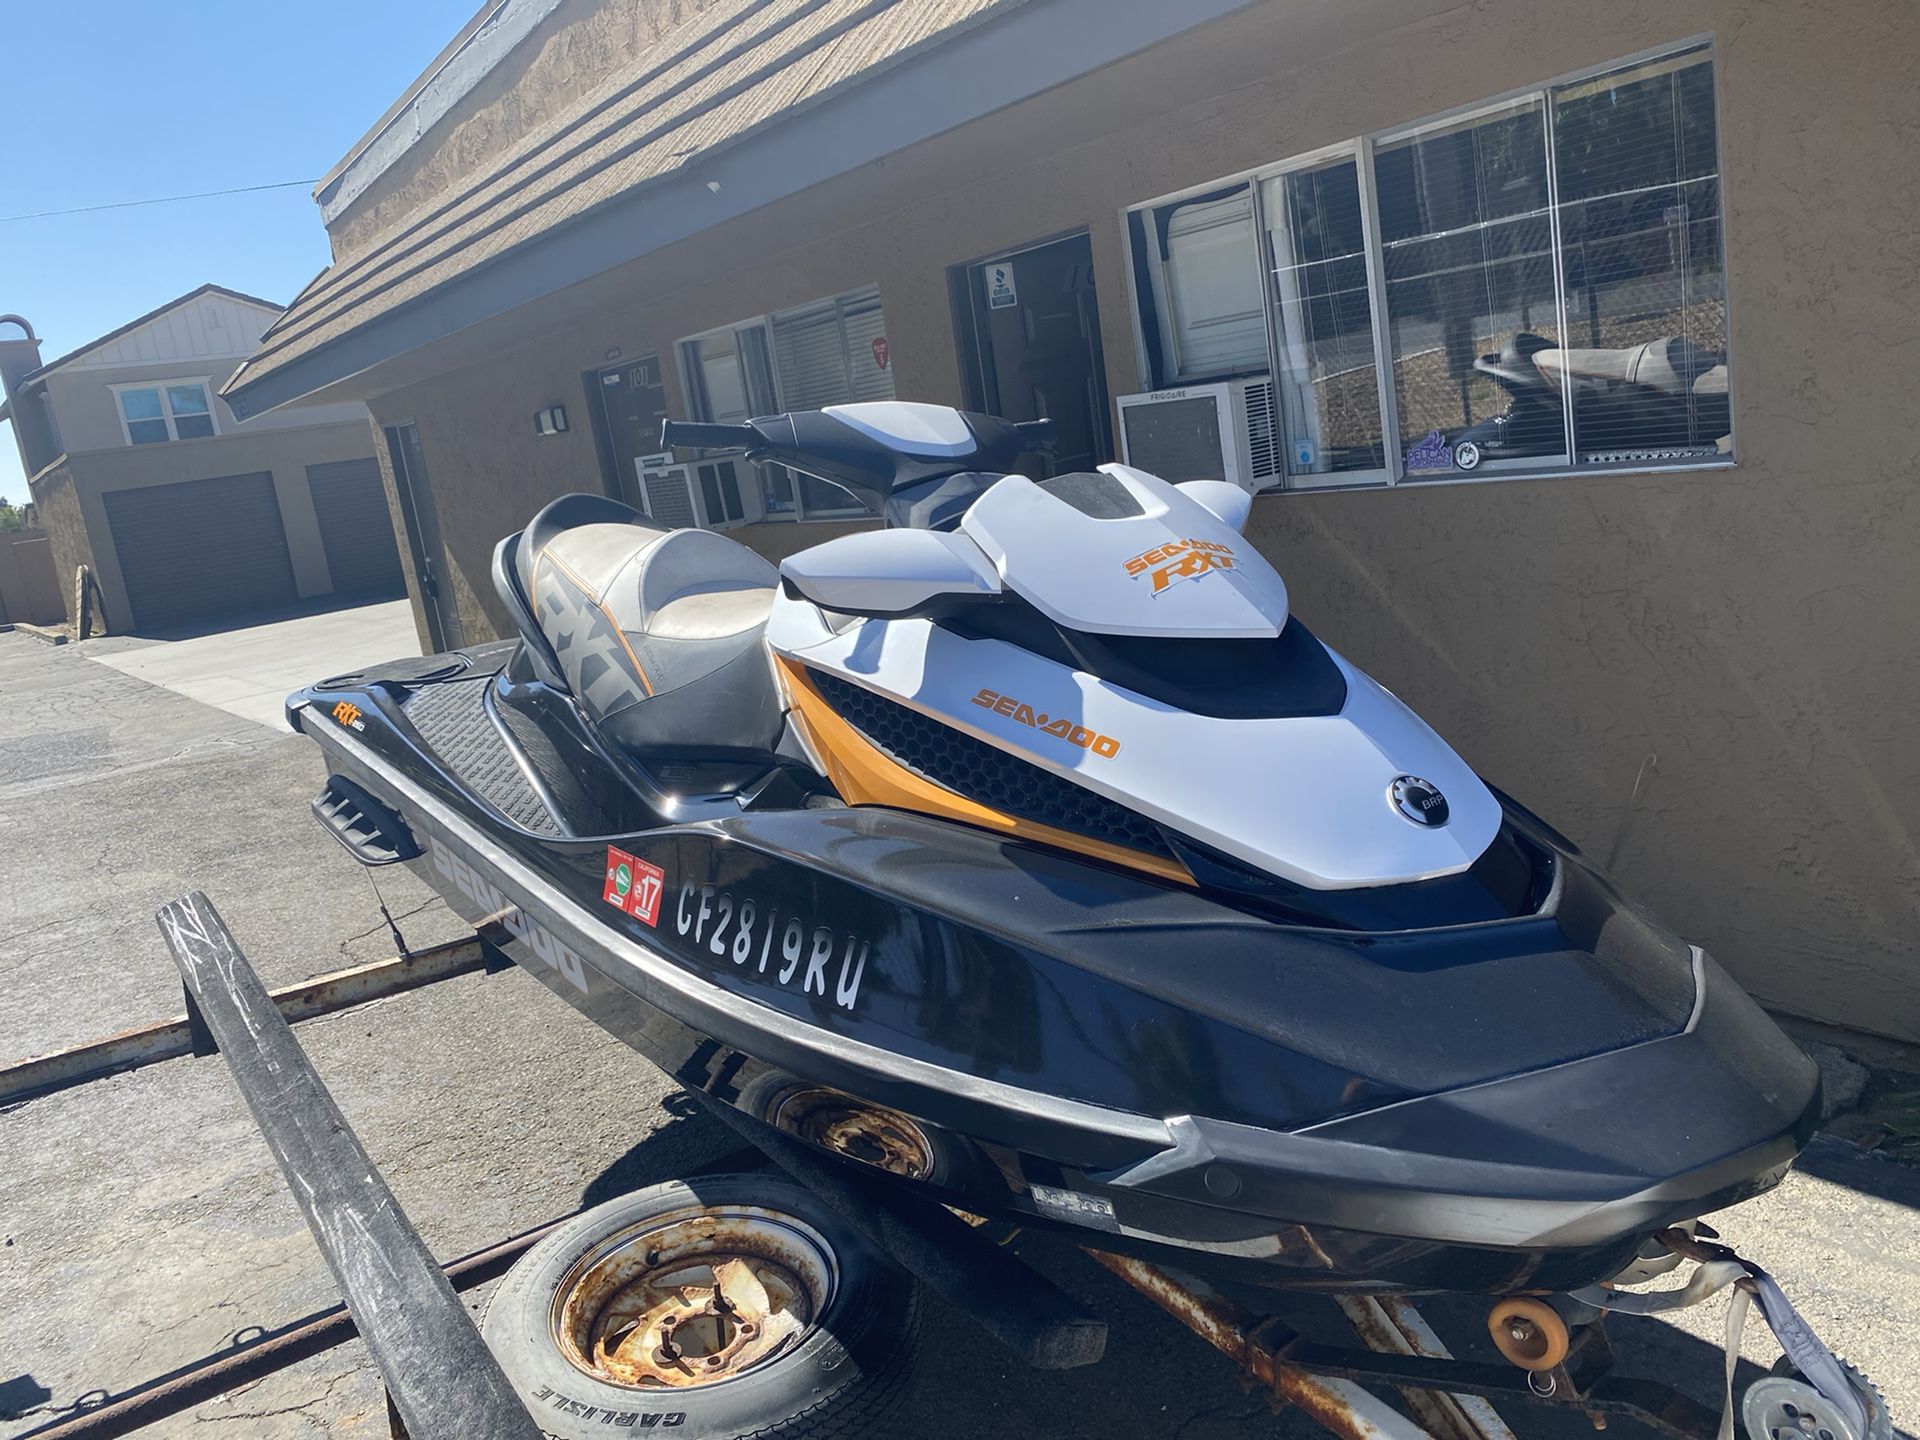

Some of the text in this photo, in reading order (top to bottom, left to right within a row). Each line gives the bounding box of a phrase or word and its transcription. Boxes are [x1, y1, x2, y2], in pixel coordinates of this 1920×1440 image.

[1150, 390, 1186, 401] FRIGIDAIRE
[1407, 446, 1452, 461] PELICAN
[1151, 550, 1234, 593] RXT
[332, 700, 362, 726] RXT
[1421, 794, 1443, 810] BRP
[641, 874, 661, 912] 17
[531, 1383, 688, 1428] CARLISLE
